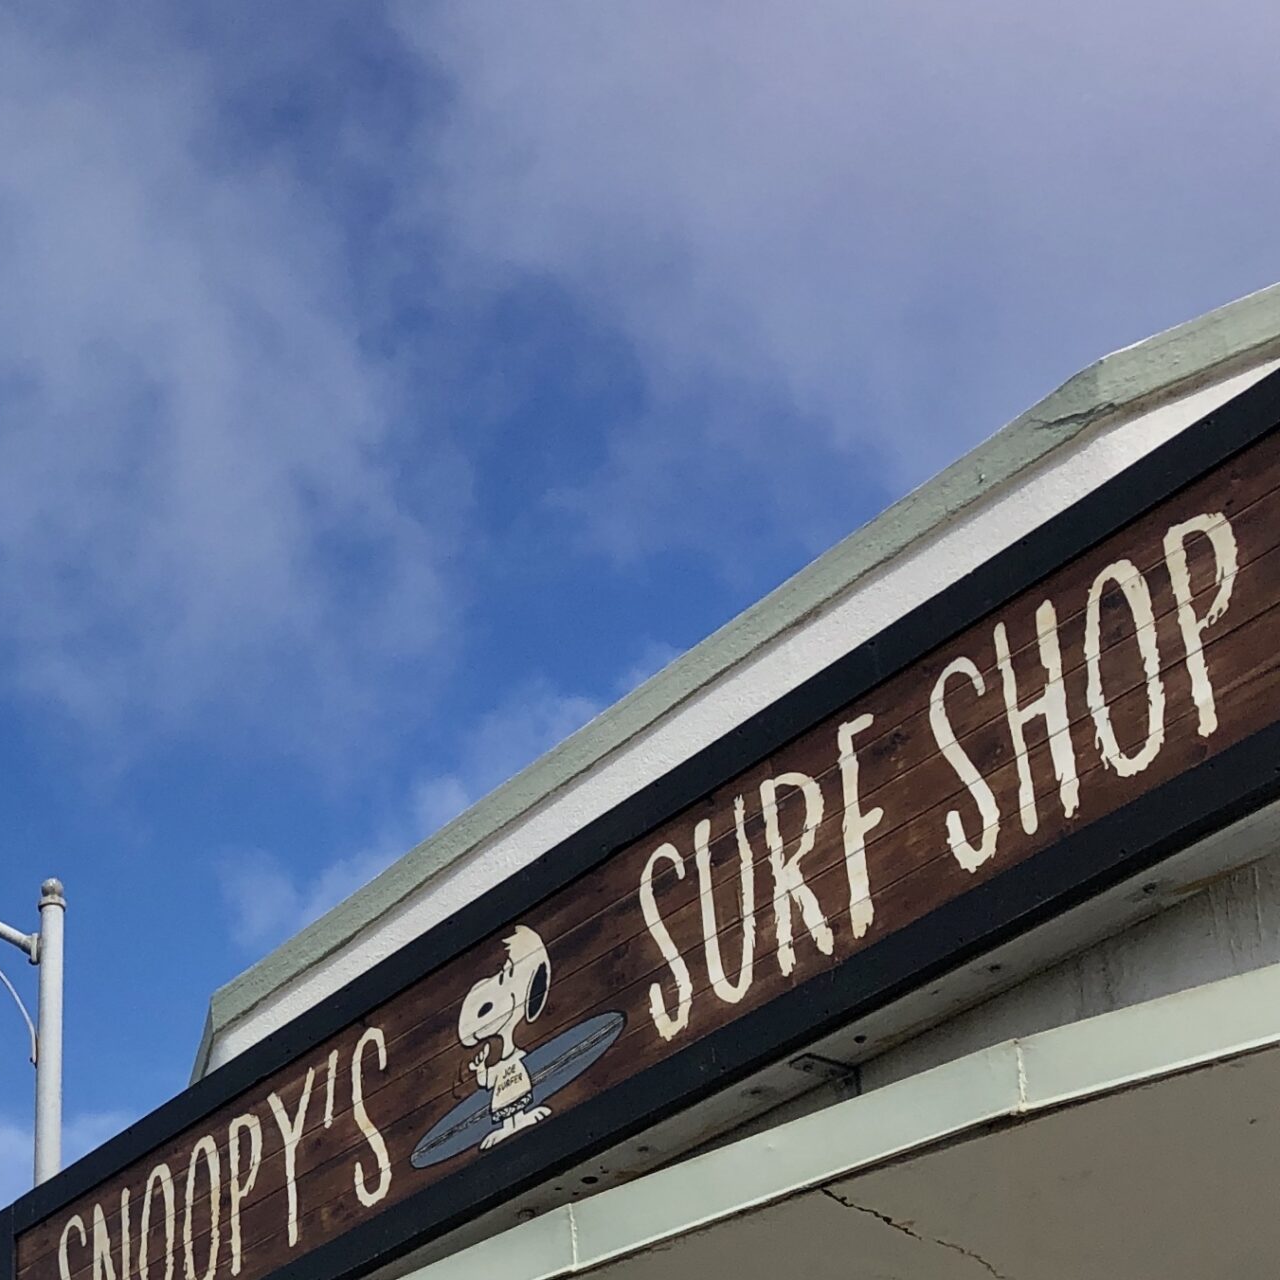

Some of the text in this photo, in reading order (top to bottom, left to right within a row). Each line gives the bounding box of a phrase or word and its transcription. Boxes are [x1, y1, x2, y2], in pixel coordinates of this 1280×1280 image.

[639, 713, 884, 1042] SURF
[929, 511, 1239, 874] SHOP
[502, 1063, 516, 1079] JOE
[496, 1072, 523, 1097] SURFER
